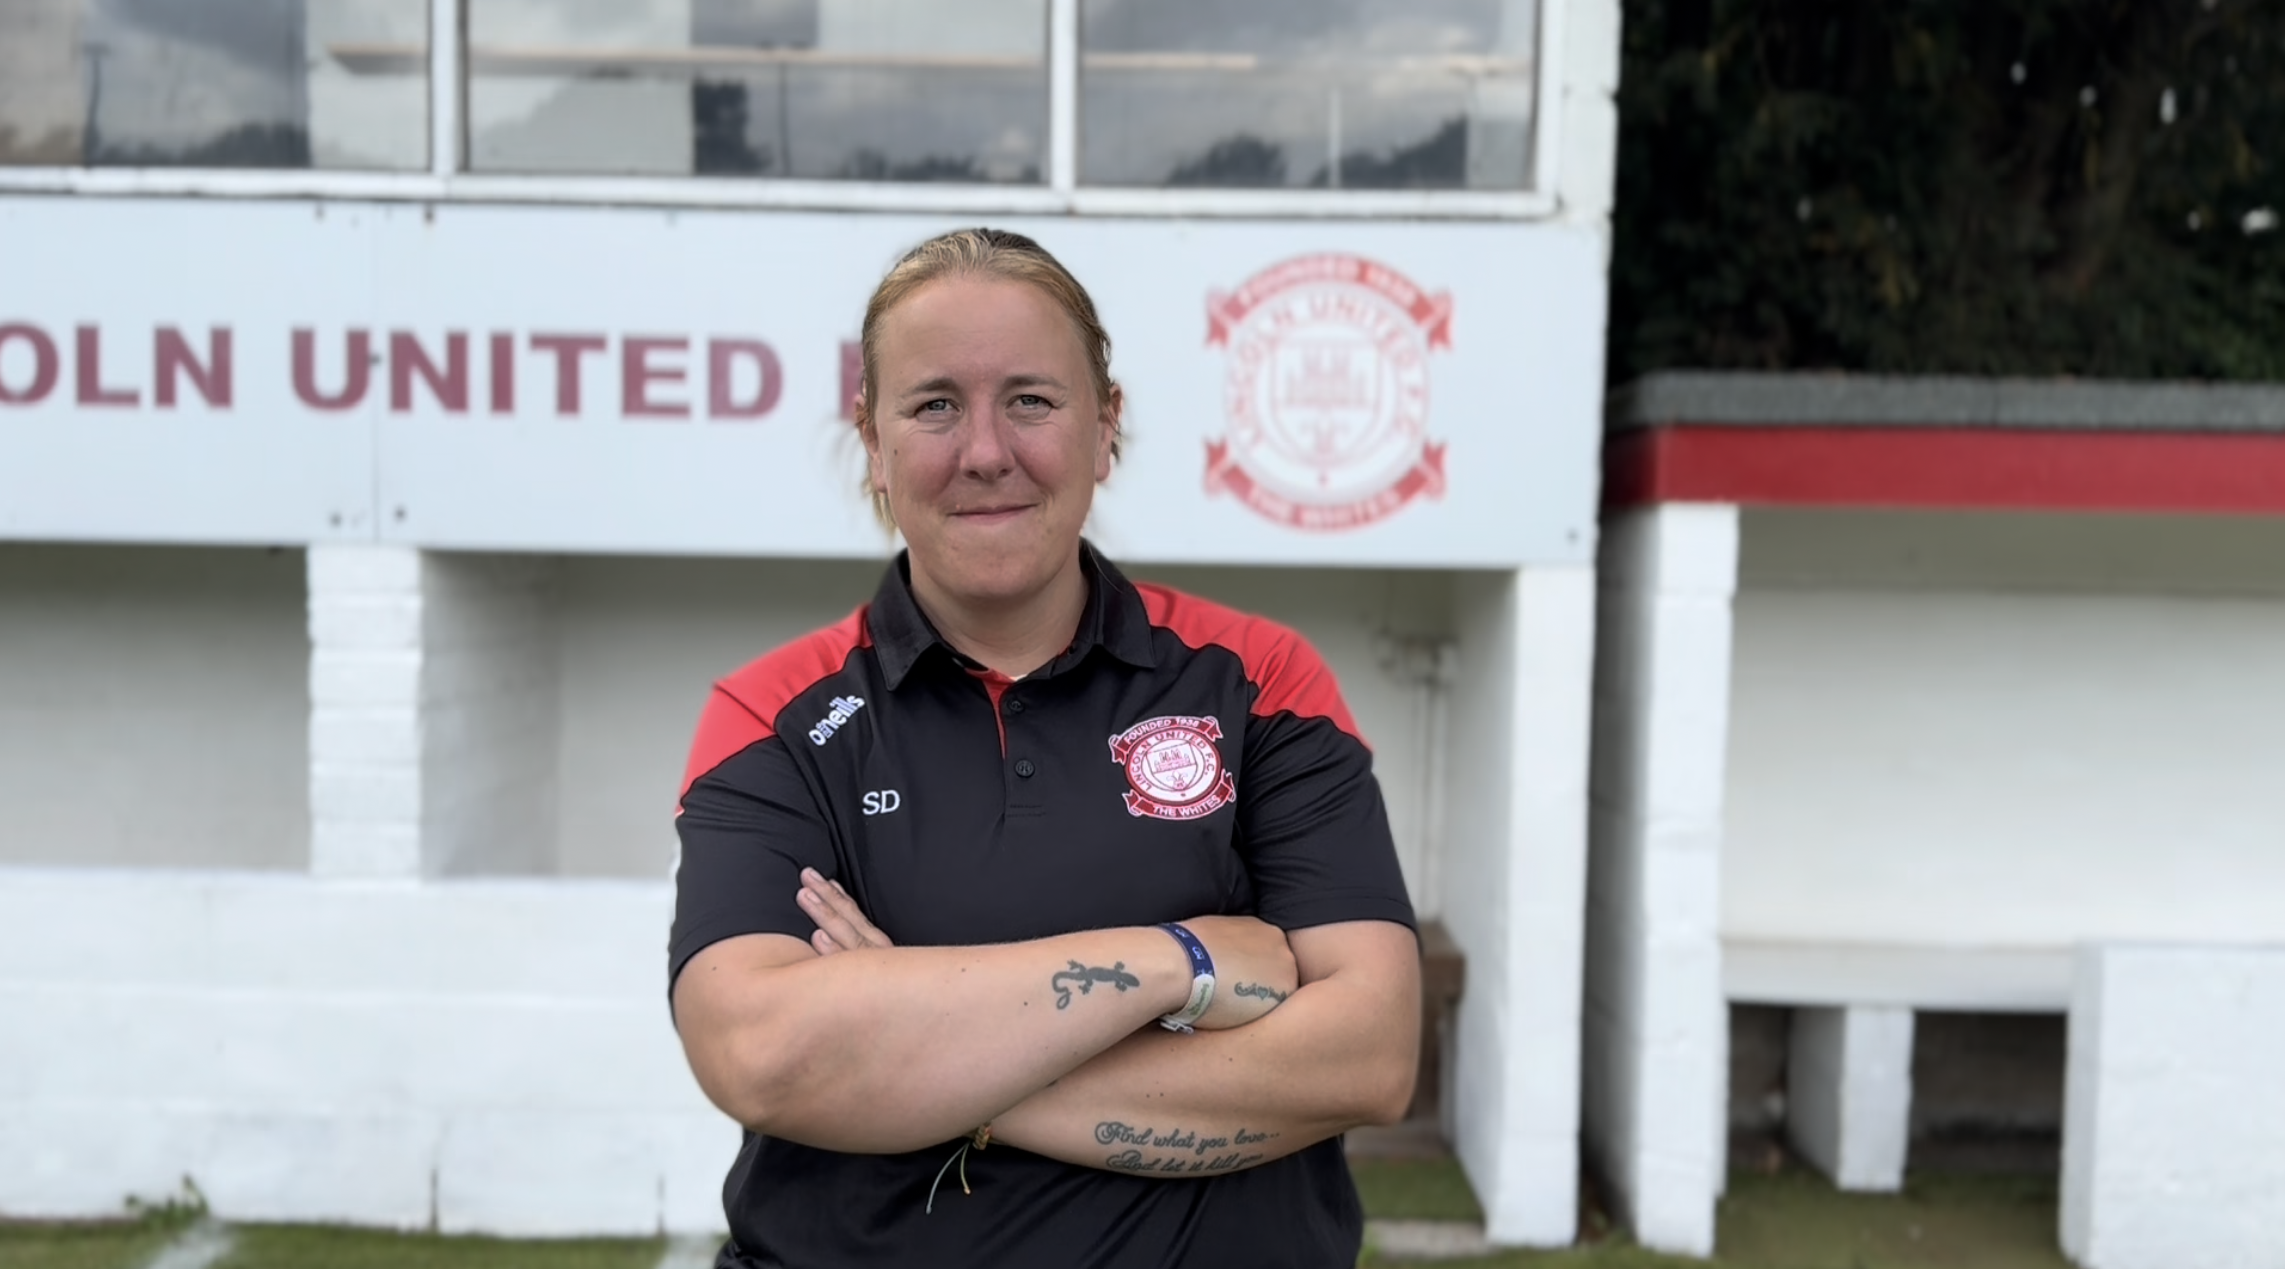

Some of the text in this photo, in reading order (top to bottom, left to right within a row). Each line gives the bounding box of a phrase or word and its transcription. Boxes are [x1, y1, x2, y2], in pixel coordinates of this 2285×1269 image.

[291, 327, 783, 420] UNITED
[1124, 717, 1200, 745] FOUNDED 1938
[1131, 742, 1152, 791] LINCOLN
[1154, 730, 1207, 750] UNITED
[862, 790, 901, 816] SD
[1153, 793, 1221, 817] THE WHITES
[1094, 1121, 1154, 1146] Find
[1153, 1128, 1195, 1149] what
[1195, 1137, 1229, 1156] you
[1160, 1157, 1186, 1172] let
